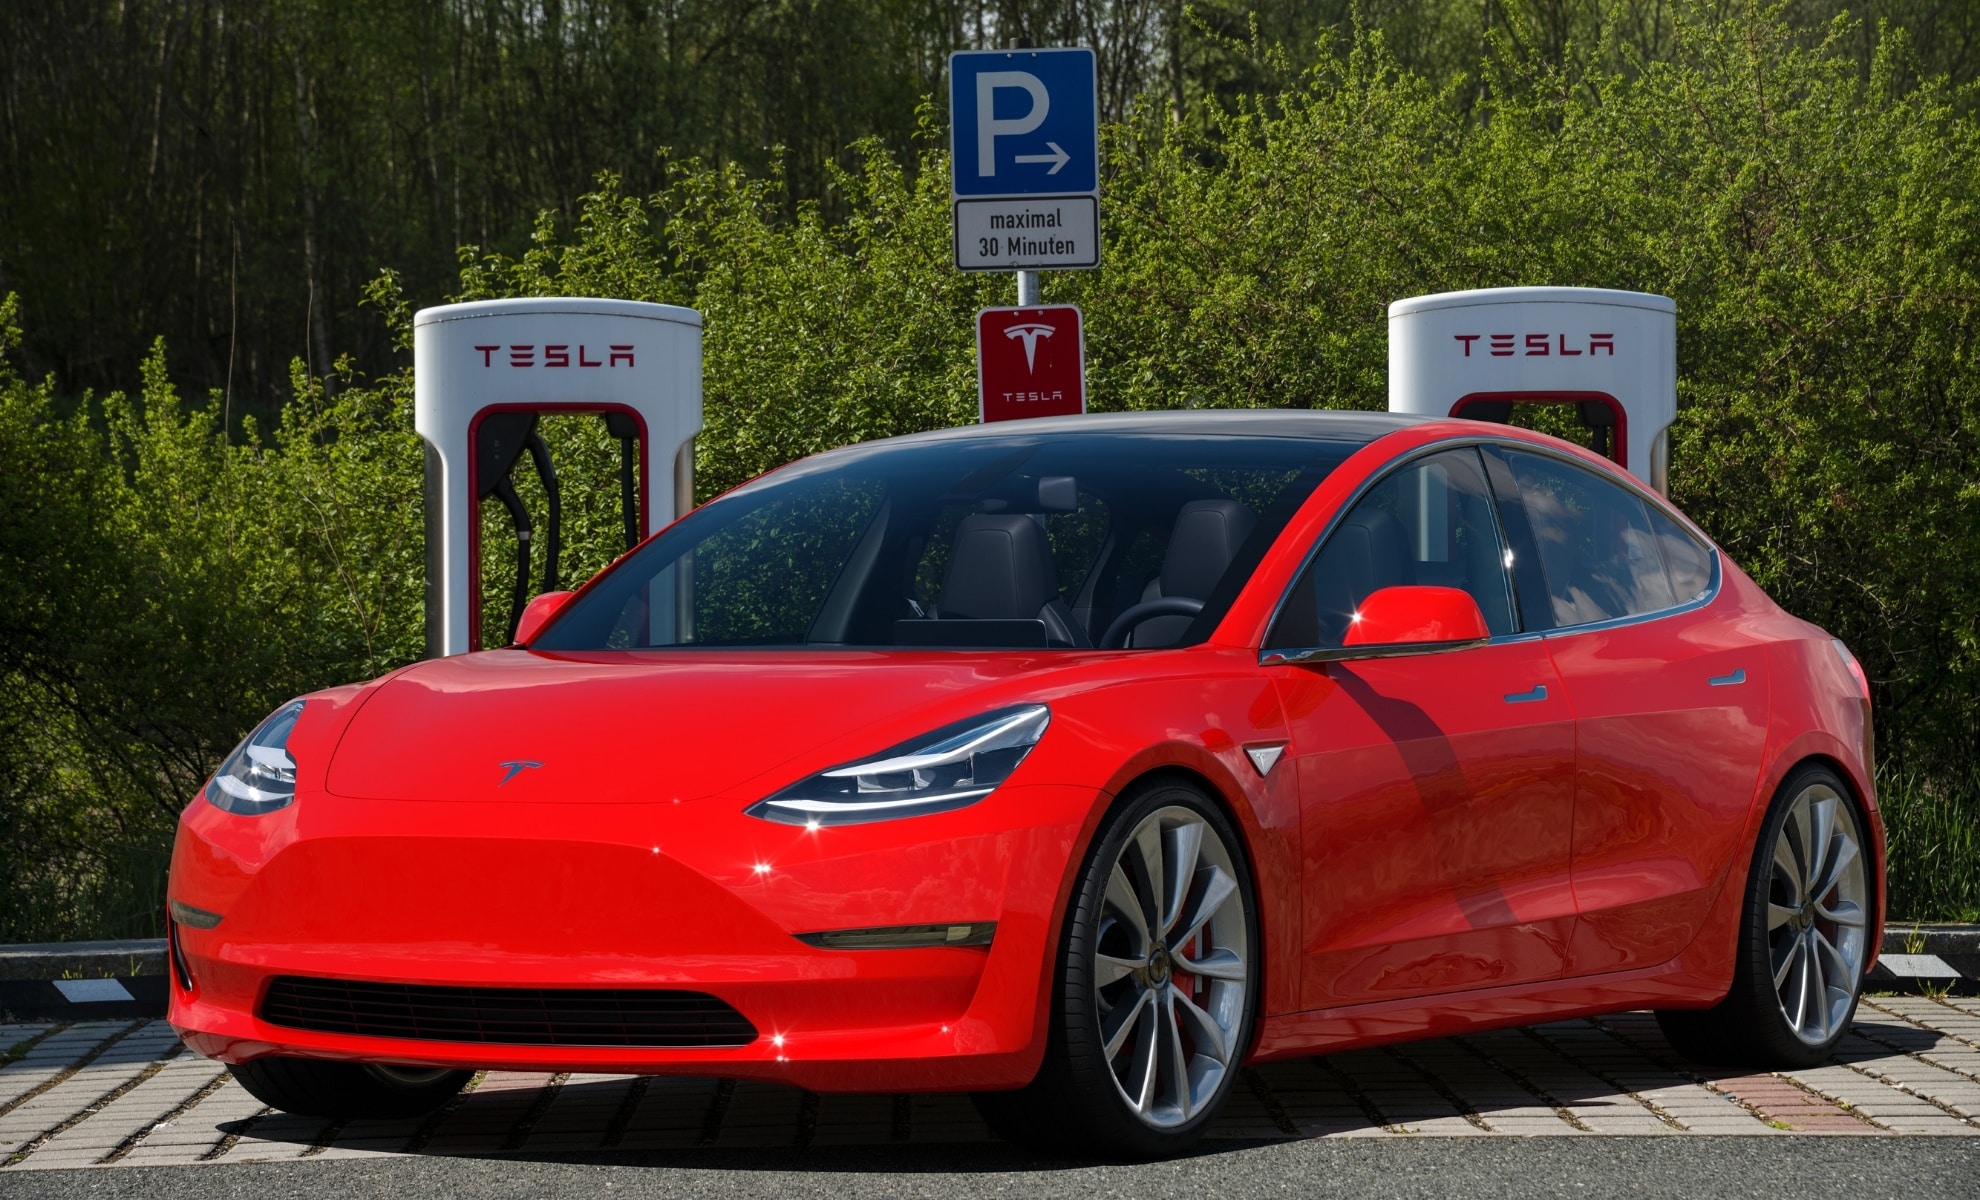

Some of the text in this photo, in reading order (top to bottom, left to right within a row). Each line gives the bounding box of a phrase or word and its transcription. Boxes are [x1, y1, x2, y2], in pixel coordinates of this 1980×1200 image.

[976, 71, 1050, 177] P
[990, 208, 1062, 229] maximal
[979, 235, 1075, 257] 30 Minuten
[474, 345, 634, 367] TESLA
[1454, 333, 1614, 357] TESLA
[1003, 391, 1062, 402] TESLA
